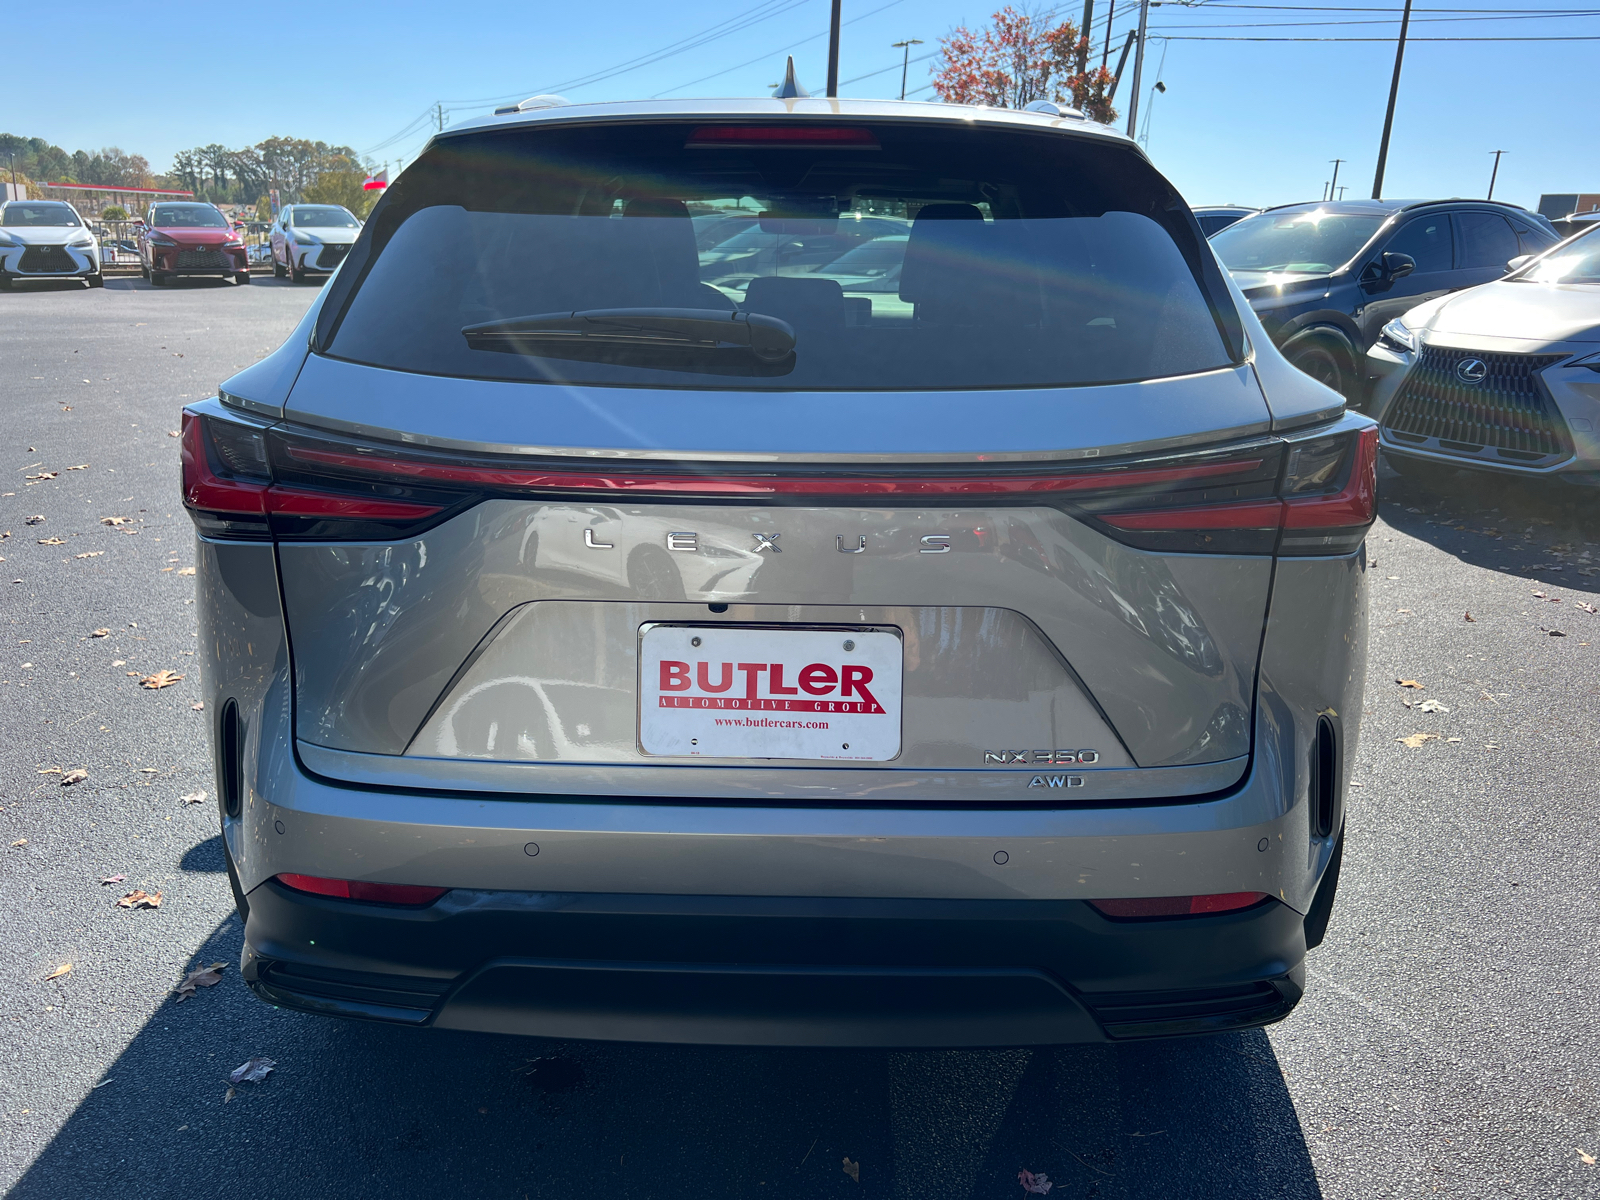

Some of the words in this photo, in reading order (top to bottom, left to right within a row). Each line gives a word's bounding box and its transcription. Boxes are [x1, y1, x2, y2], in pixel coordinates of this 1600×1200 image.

[584, 528, 951, 554] LEXUS
[660, 697, 792, 711] AUTOMOTIVE
[814, 701, 879, 713] GROUP
[714, 717, 830, 730] www.butlercars.com
[1026, 774, 1085, 789] AWD
